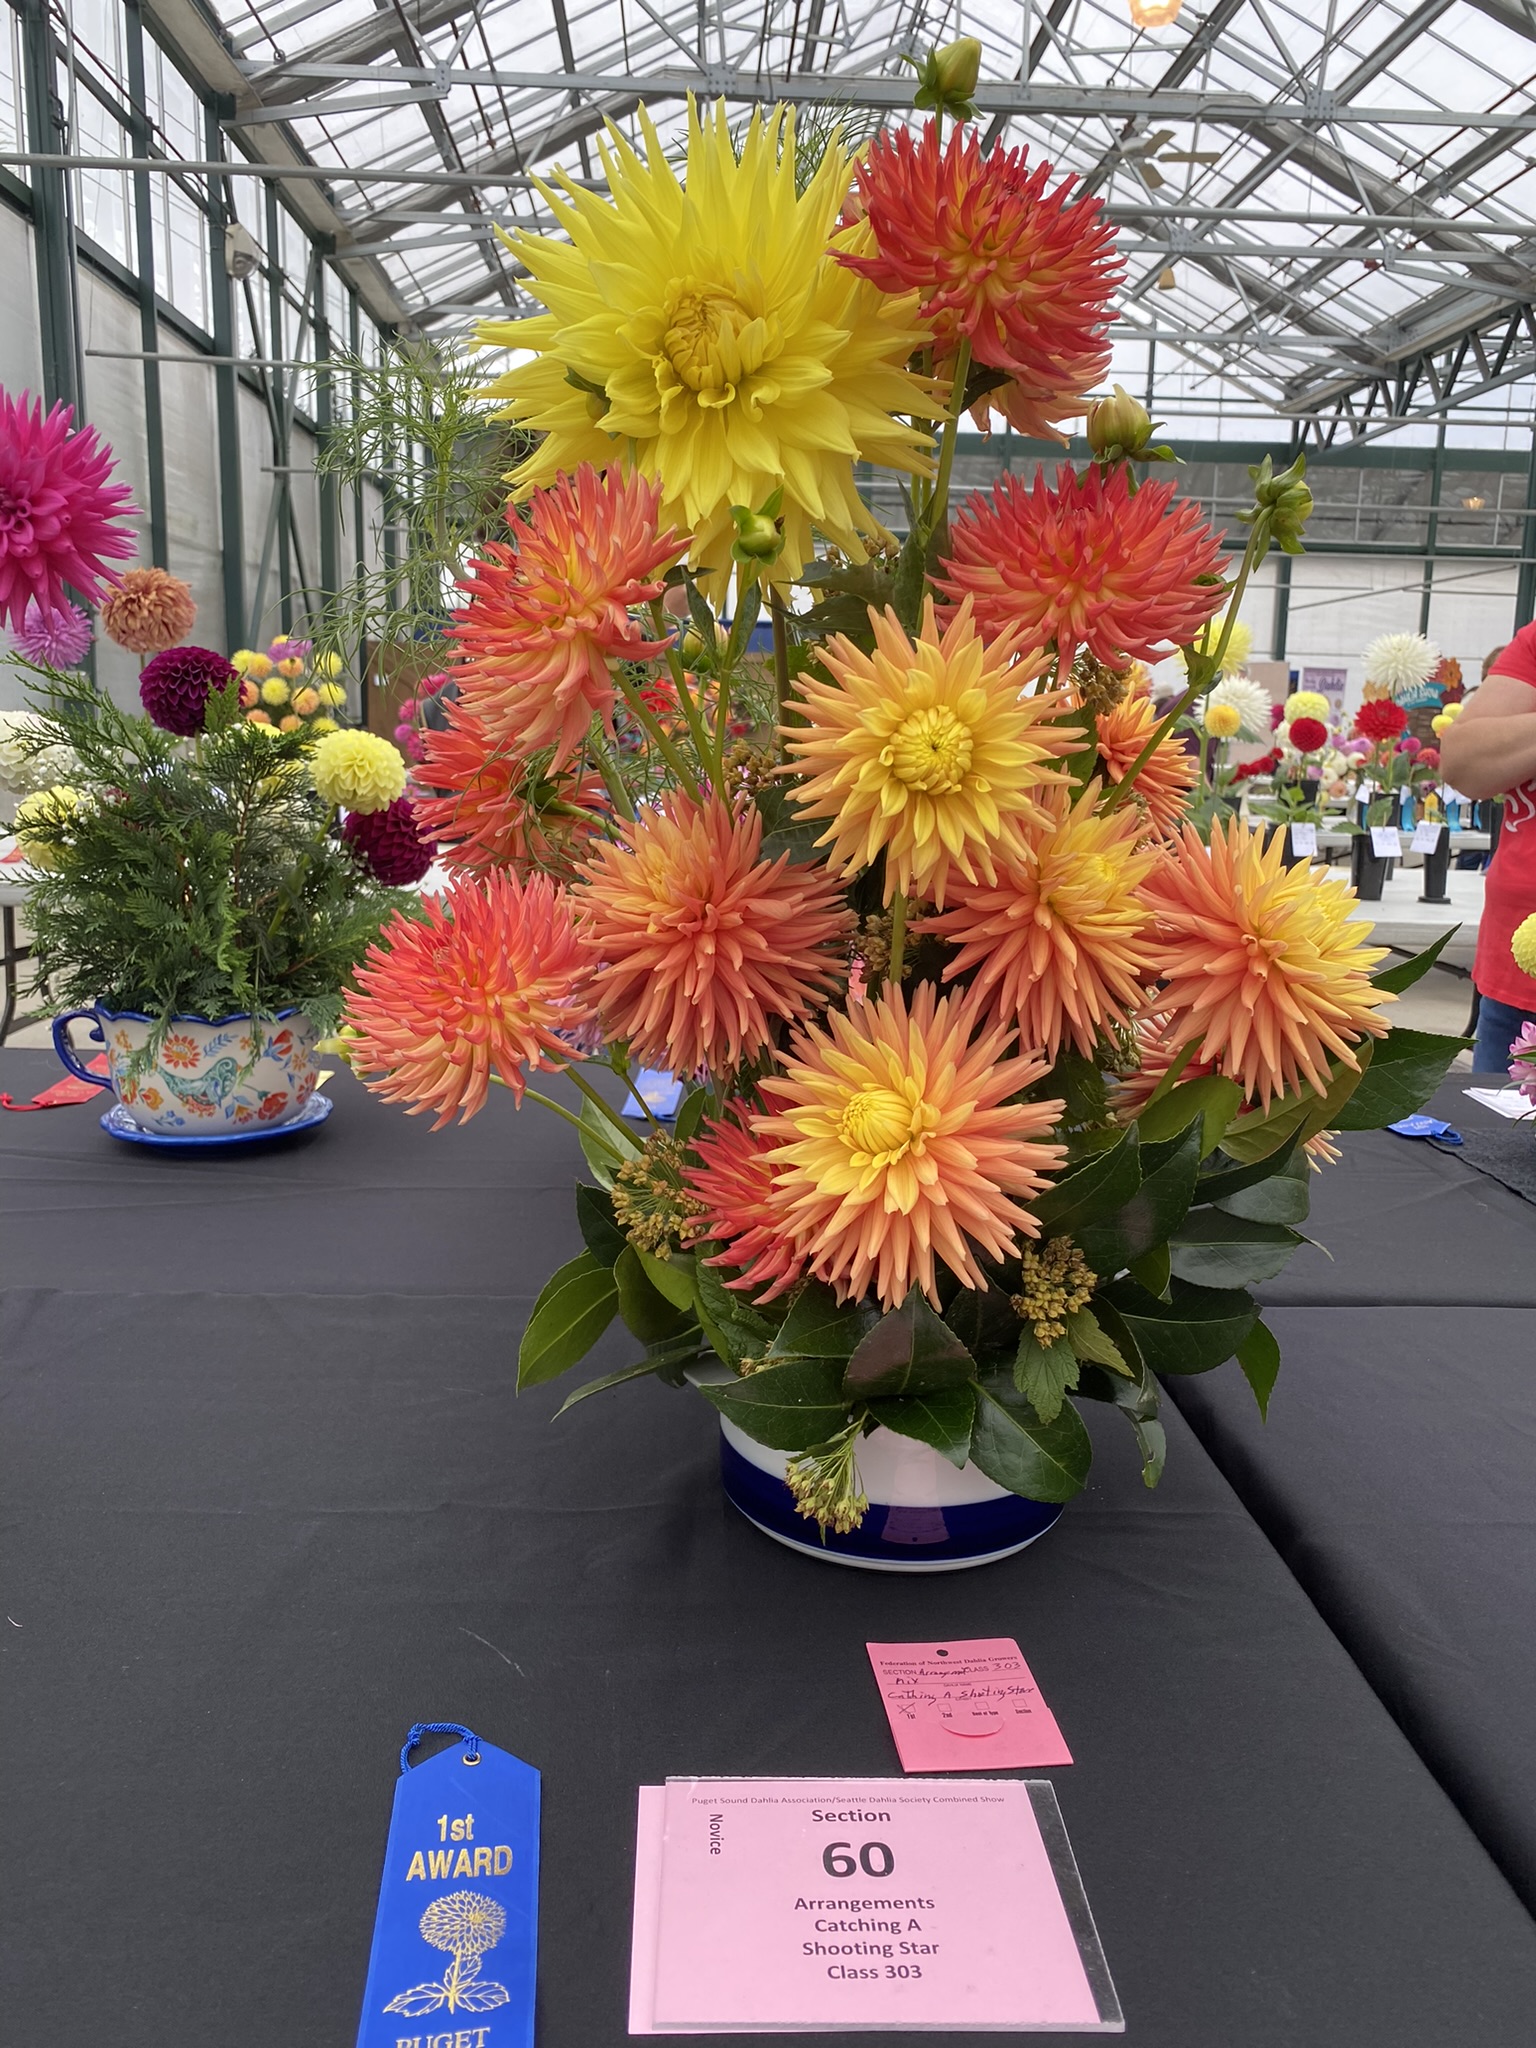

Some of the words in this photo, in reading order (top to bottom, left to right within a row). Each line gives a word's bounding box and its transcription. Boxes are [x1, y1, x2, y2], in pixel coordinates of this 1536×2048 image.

[992, 1661, 1021, 1670] 303
[691, 1797, 717, 1806] Puget
[781, 1796, 866, 1804] Association/Seattle
[868, 1796, 897, 1804] Dahlia
[898, 1796, 931, 1804] Society
[811, 1809, 891, 1822] Section
[437, 1813, 475, 1842] 1st
[709, 1813, 725, 1855] Novice
[405, 1845, 513, 1881] AWARD
[822, 1841, 895, 1878] 60
[794, 1897, 936, 1913] Arrangements
[814, 1918, 902, 1935] Catching
[907, 1918, 922, 1931] A
[802, 1941, 894, 1958] Shooting
[899, 1941, 940, 1955] Star
[827, 1965, 879, 1979] Class
[884, 1964, 923, 1979] 303
[395, 2026, 491, 2048] PUGET
